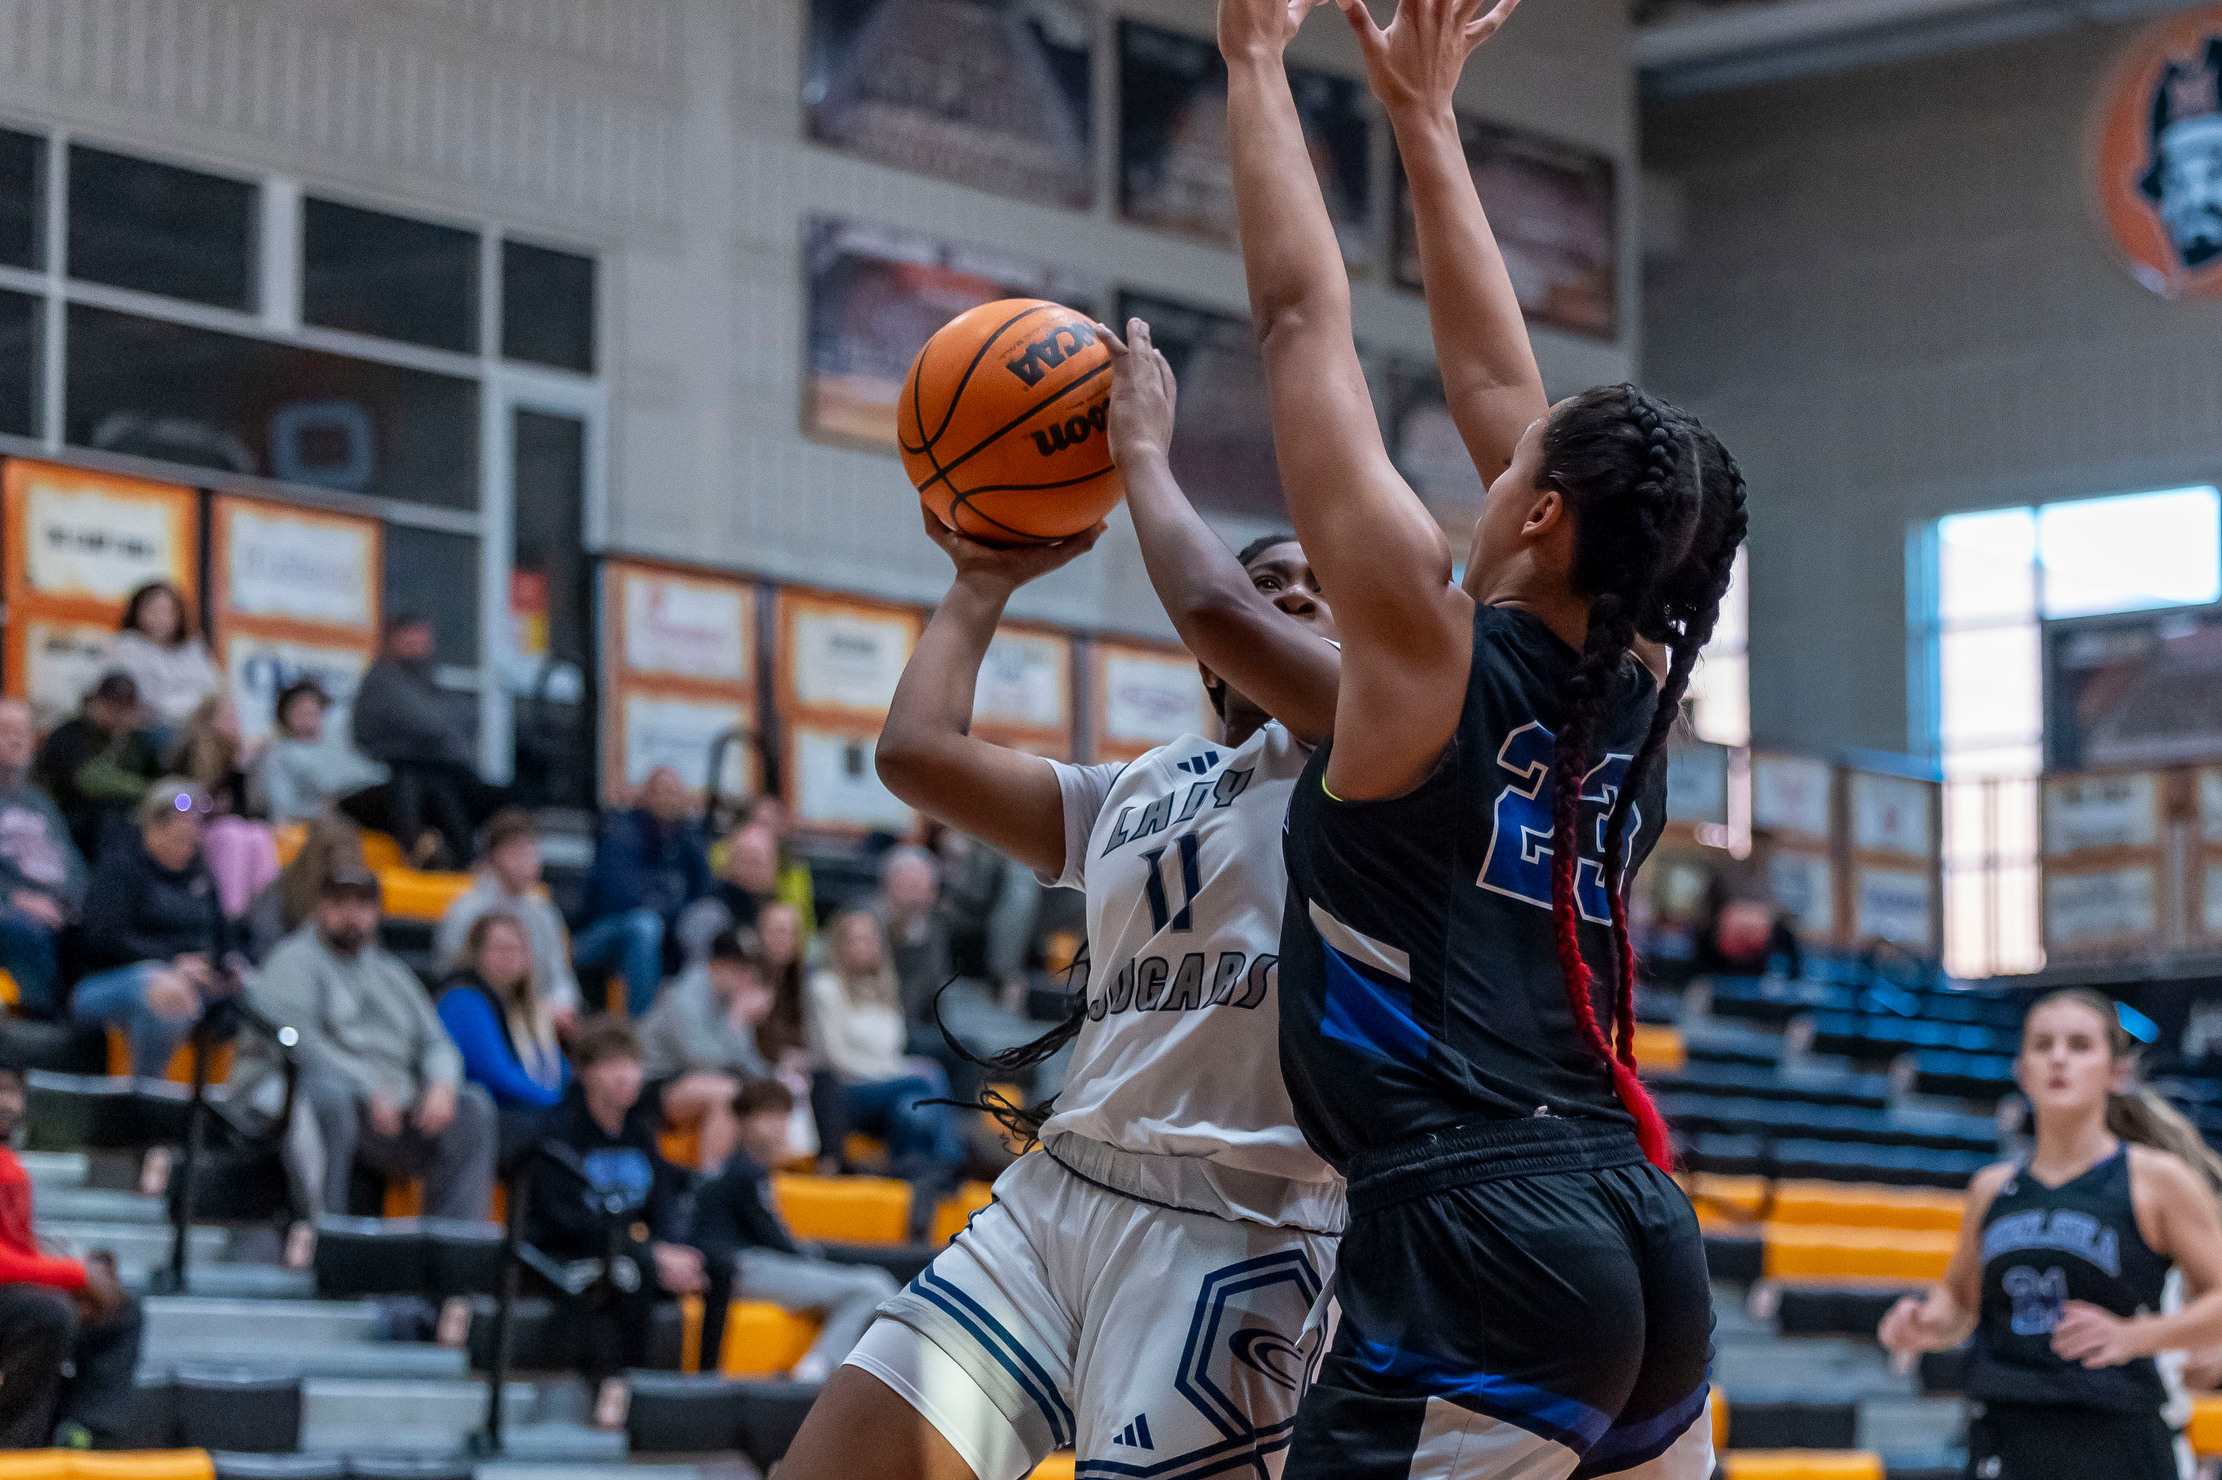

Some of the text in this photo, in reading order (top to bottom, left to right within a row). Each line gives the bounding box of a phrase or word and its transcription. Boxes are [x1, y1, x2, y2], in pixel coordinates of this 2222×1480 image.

[1006, 320, 1097, 388] NCAA
[1100, 767, 1255, 859] LADY
[1476, 720, 1641, 927] 23
[1138, 830, 1202, 937] 11
[1087, 952, 1279, 1022] OUGARS
